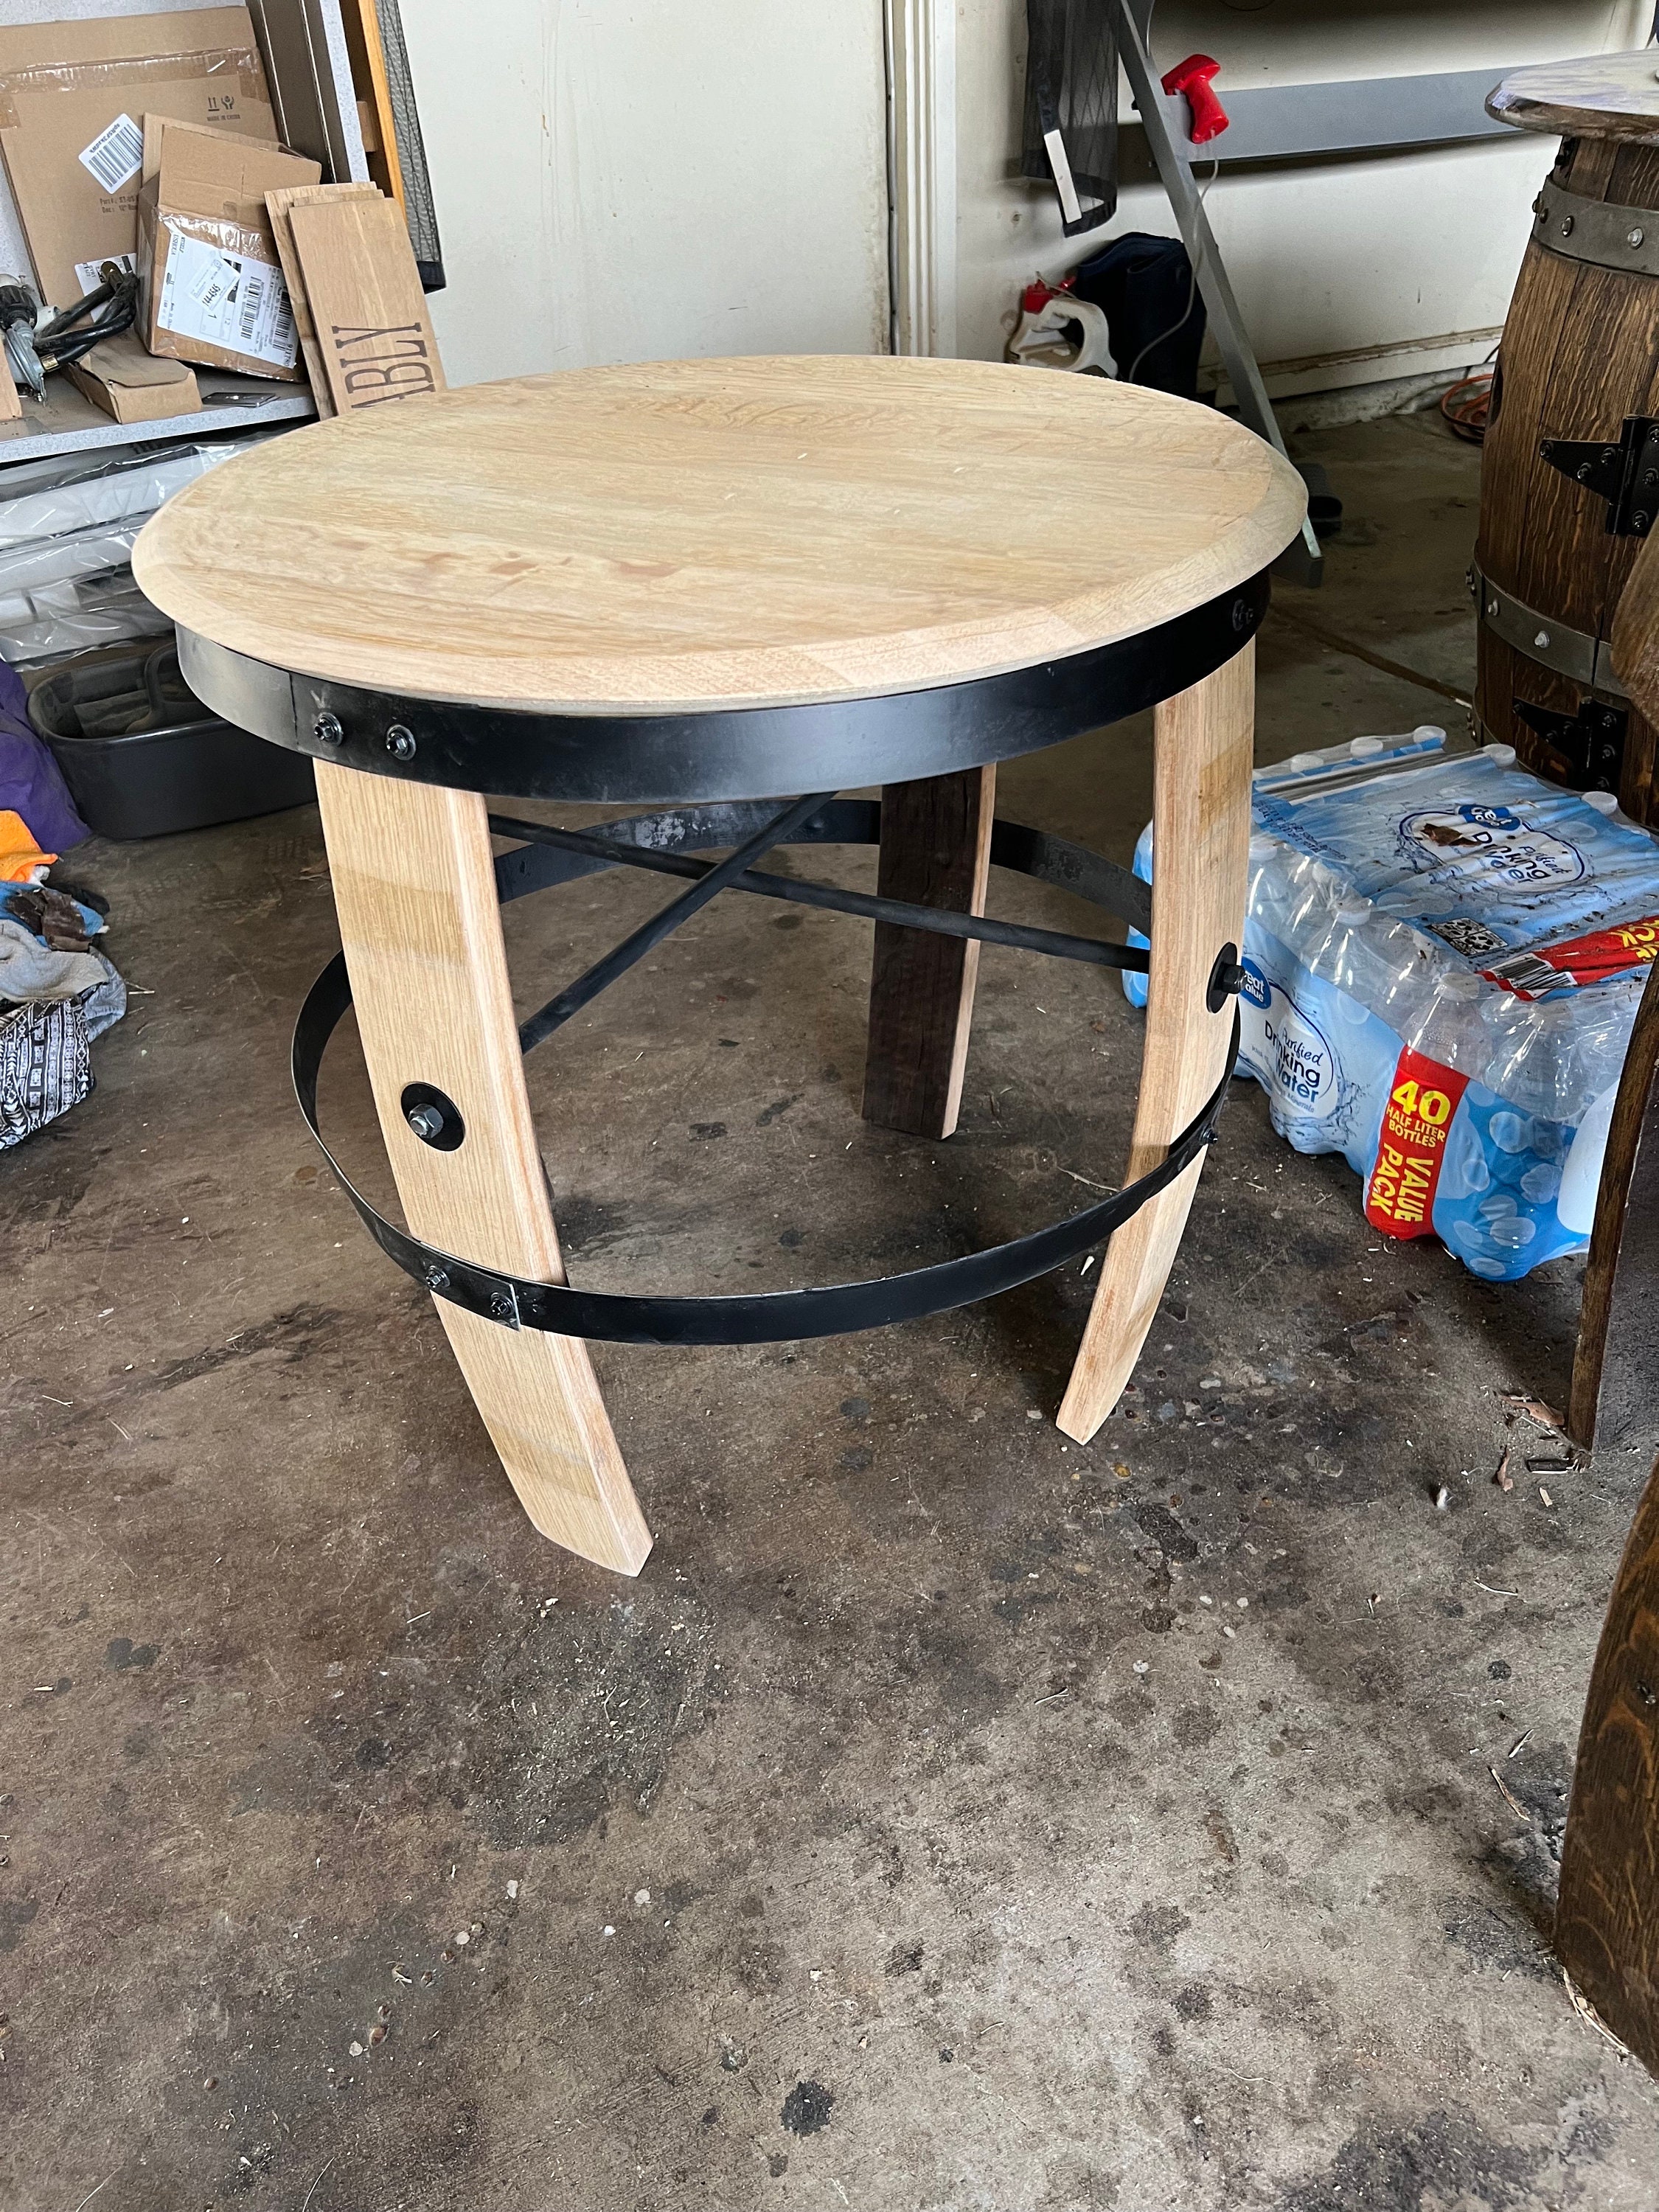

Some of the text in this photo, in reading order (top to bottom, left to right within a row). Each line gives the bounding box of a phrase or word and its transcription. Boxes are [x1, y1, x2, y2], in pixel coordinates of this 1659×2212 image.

[1245, 984, 1264, 1002] alue
[1392, 1080, 1450, 1125] 40
[1386, 1105, 1446, 1142] HALF LITER
[1388, 1120, 1436, 1148] BOTTLES
[1370, 1142, 1403, 1215] PACK
[1394, 1157, 1433, 1222] VALUE
